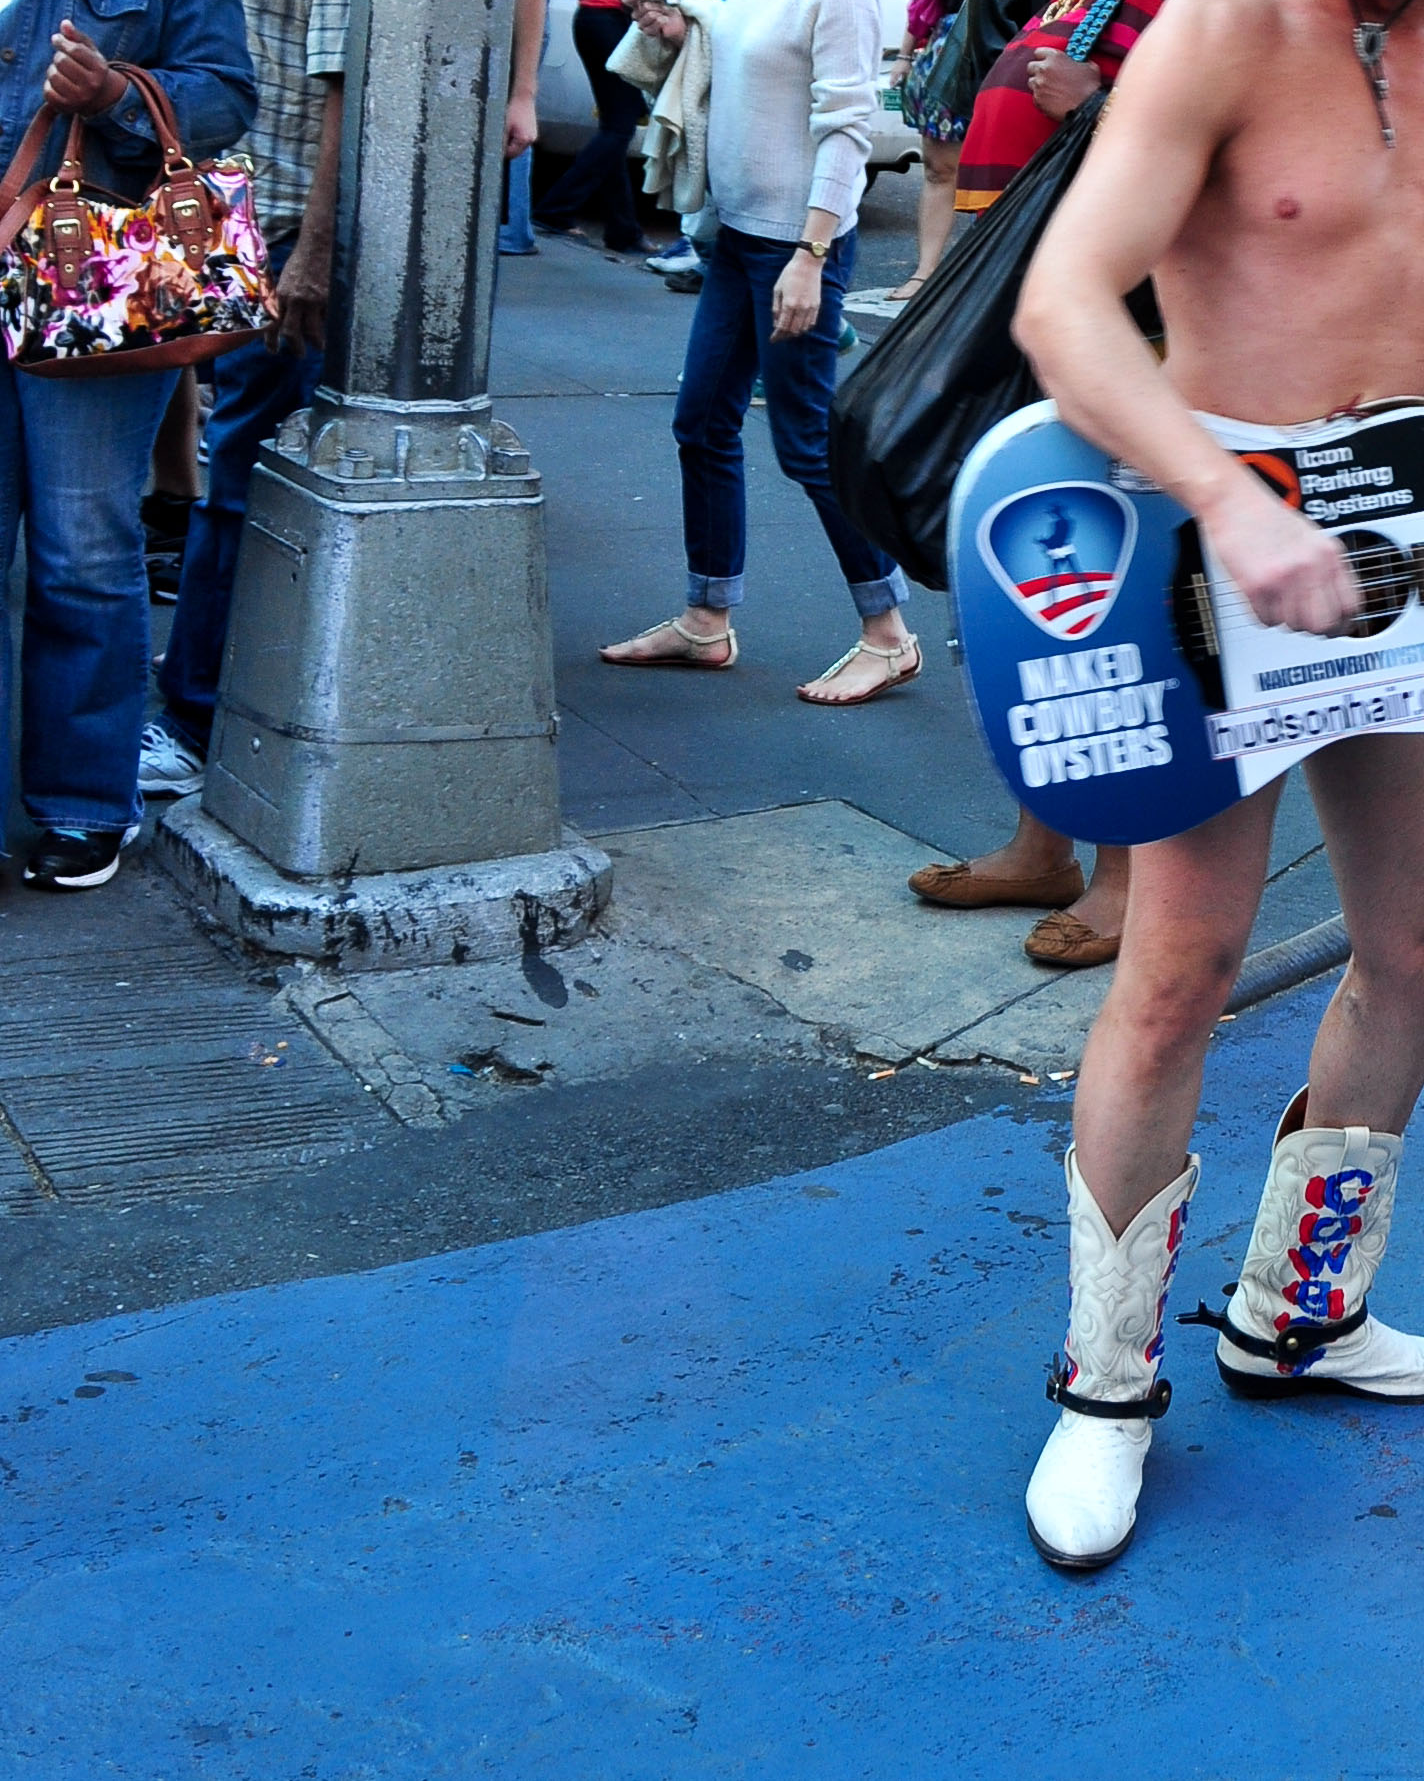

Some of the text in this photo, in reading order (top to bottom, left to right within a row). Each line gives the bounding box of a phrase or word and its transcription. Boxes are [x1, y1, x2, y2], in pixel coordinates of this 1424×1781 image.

[1295, 446, 1354, 469] Icon
[1299, 466, 1394, 495] Parking
[1304, 488, 1415, 521] Systems
[1016, 642, 1144, 702] NAKED
[1006, 680, 1166, 747] COWBOY
[1019, 724, 1174, 788] OYSTERS
